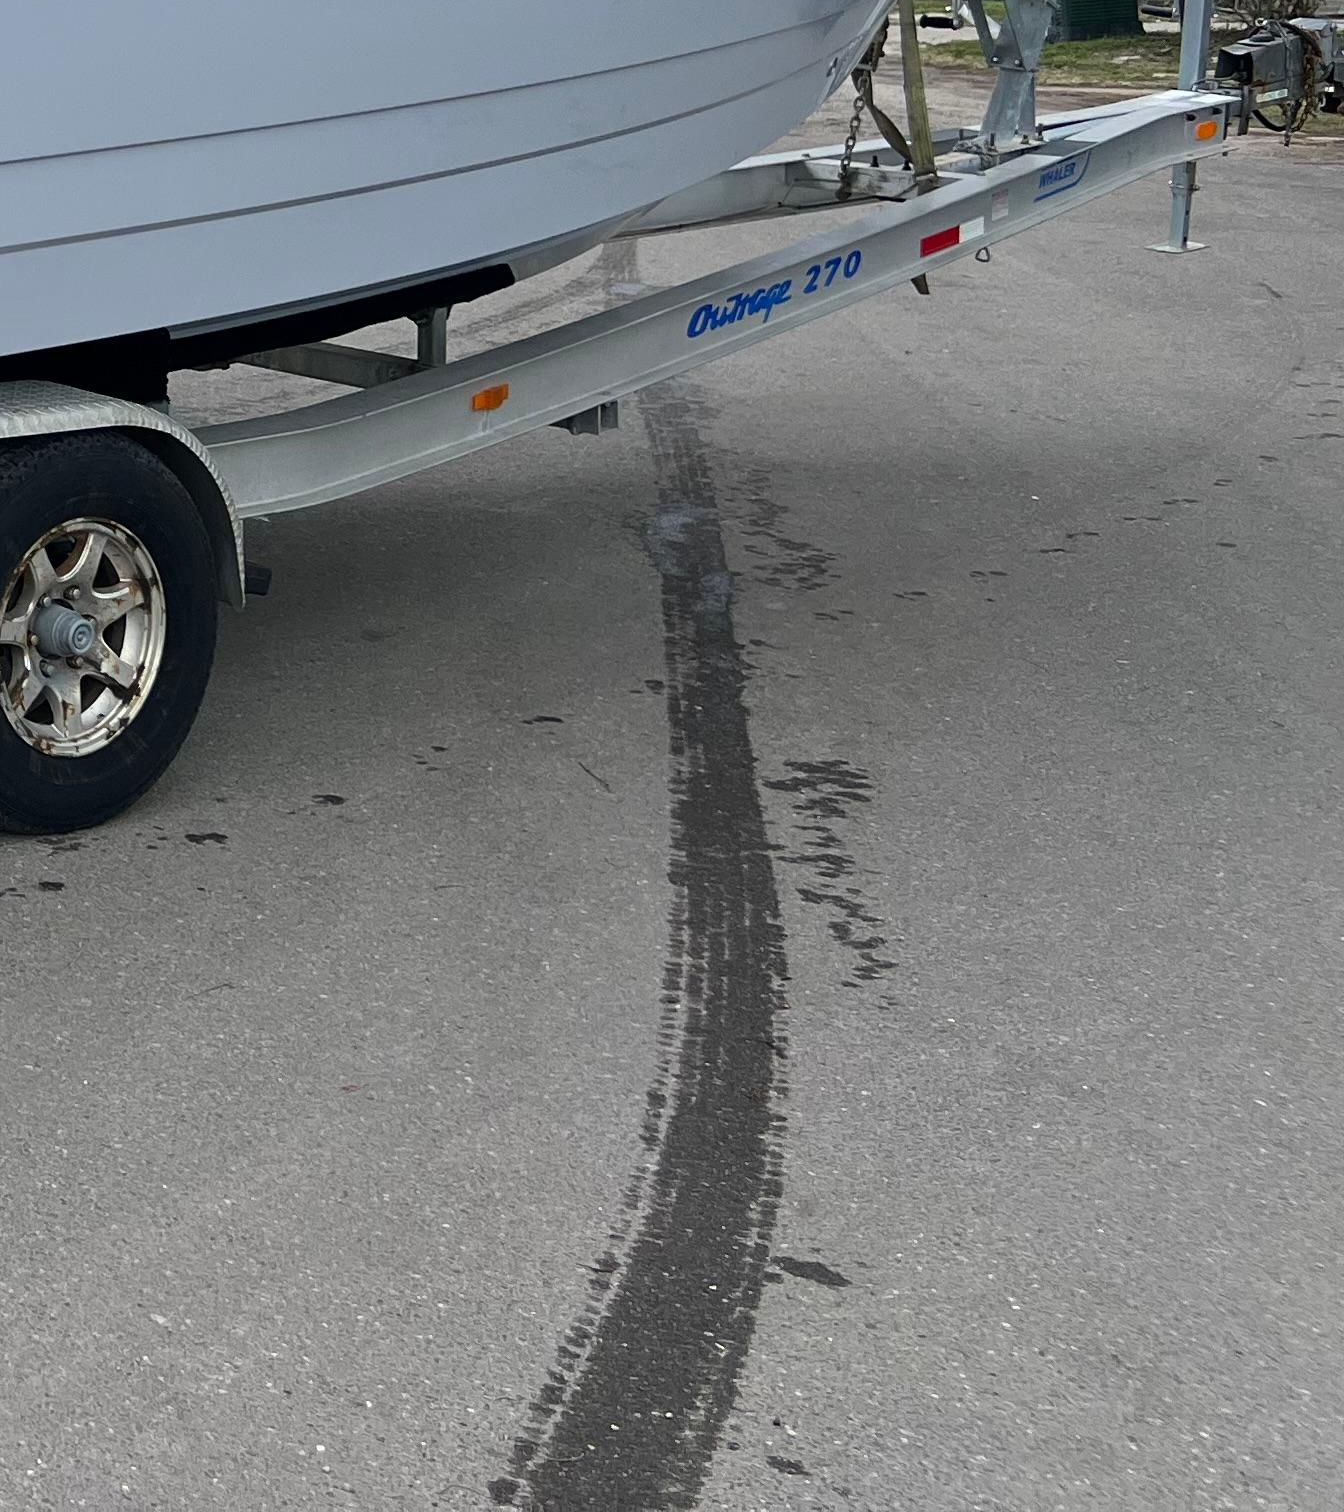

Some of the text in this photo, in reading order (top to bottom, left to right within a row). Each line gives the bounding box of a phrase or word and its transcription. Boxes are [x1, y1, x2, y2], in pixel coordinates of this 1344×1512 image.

[1039, 161, 1077, 189] WHALER
[686, 250, 862, 338] Outrage 270
